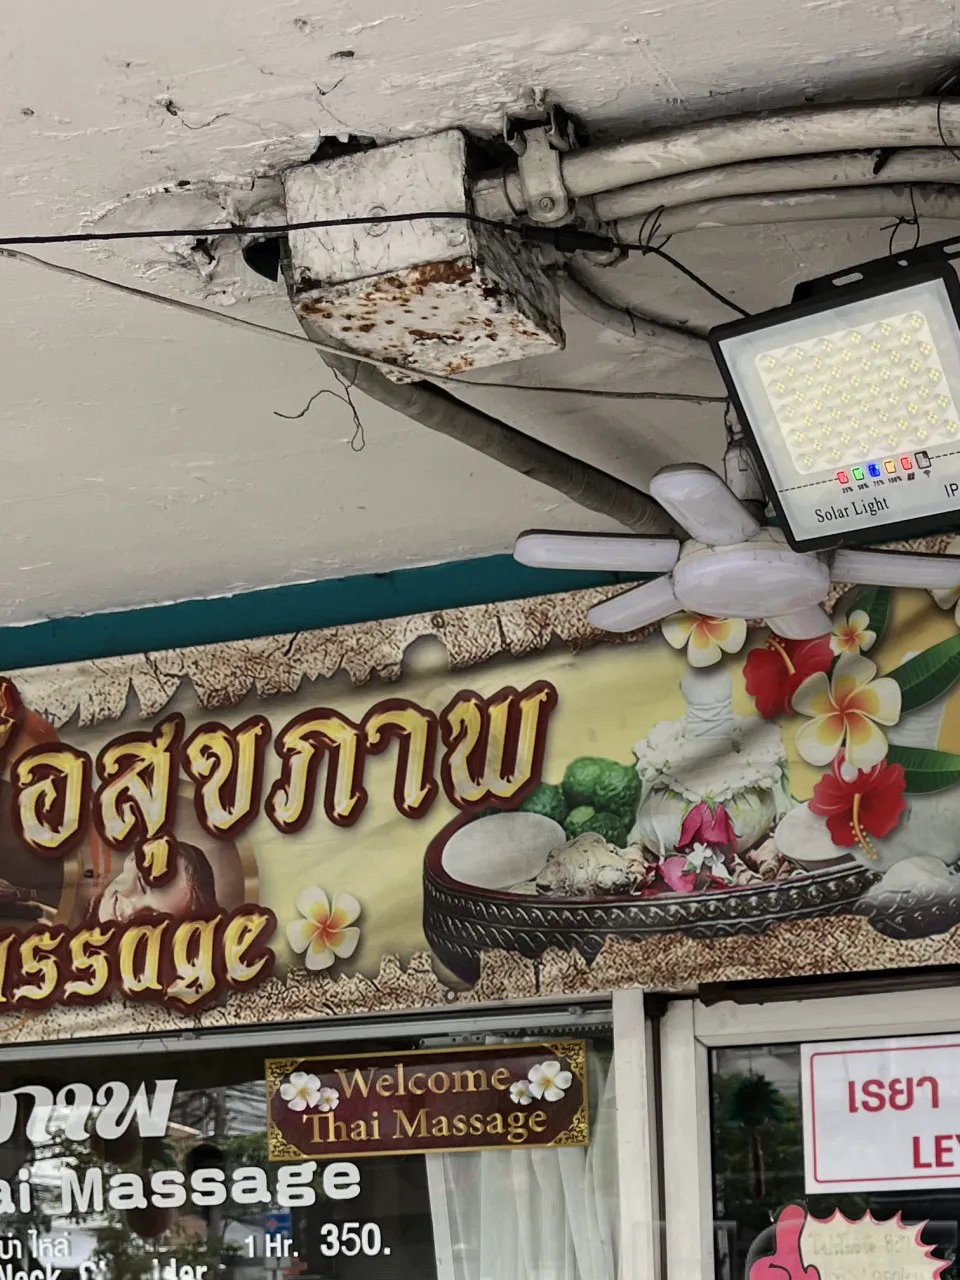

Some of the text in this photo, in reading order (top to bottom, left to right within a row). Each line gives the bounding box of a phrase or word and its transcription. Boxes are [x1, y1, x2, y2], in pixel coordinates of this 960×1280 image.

[814, 496, 890, 523] Solar Light
[0, 680, 558, 888] อสุขภาพ
[334, 1063, 511, 1099] Welcome
[847, 1073, 940, 1114] เรยา
[302, 1108, 549, 1144] Thai Massage
[61, 1160, 362, 1213] Massage
[244, 1222, 391, 1258] 1 Hr. 350.
